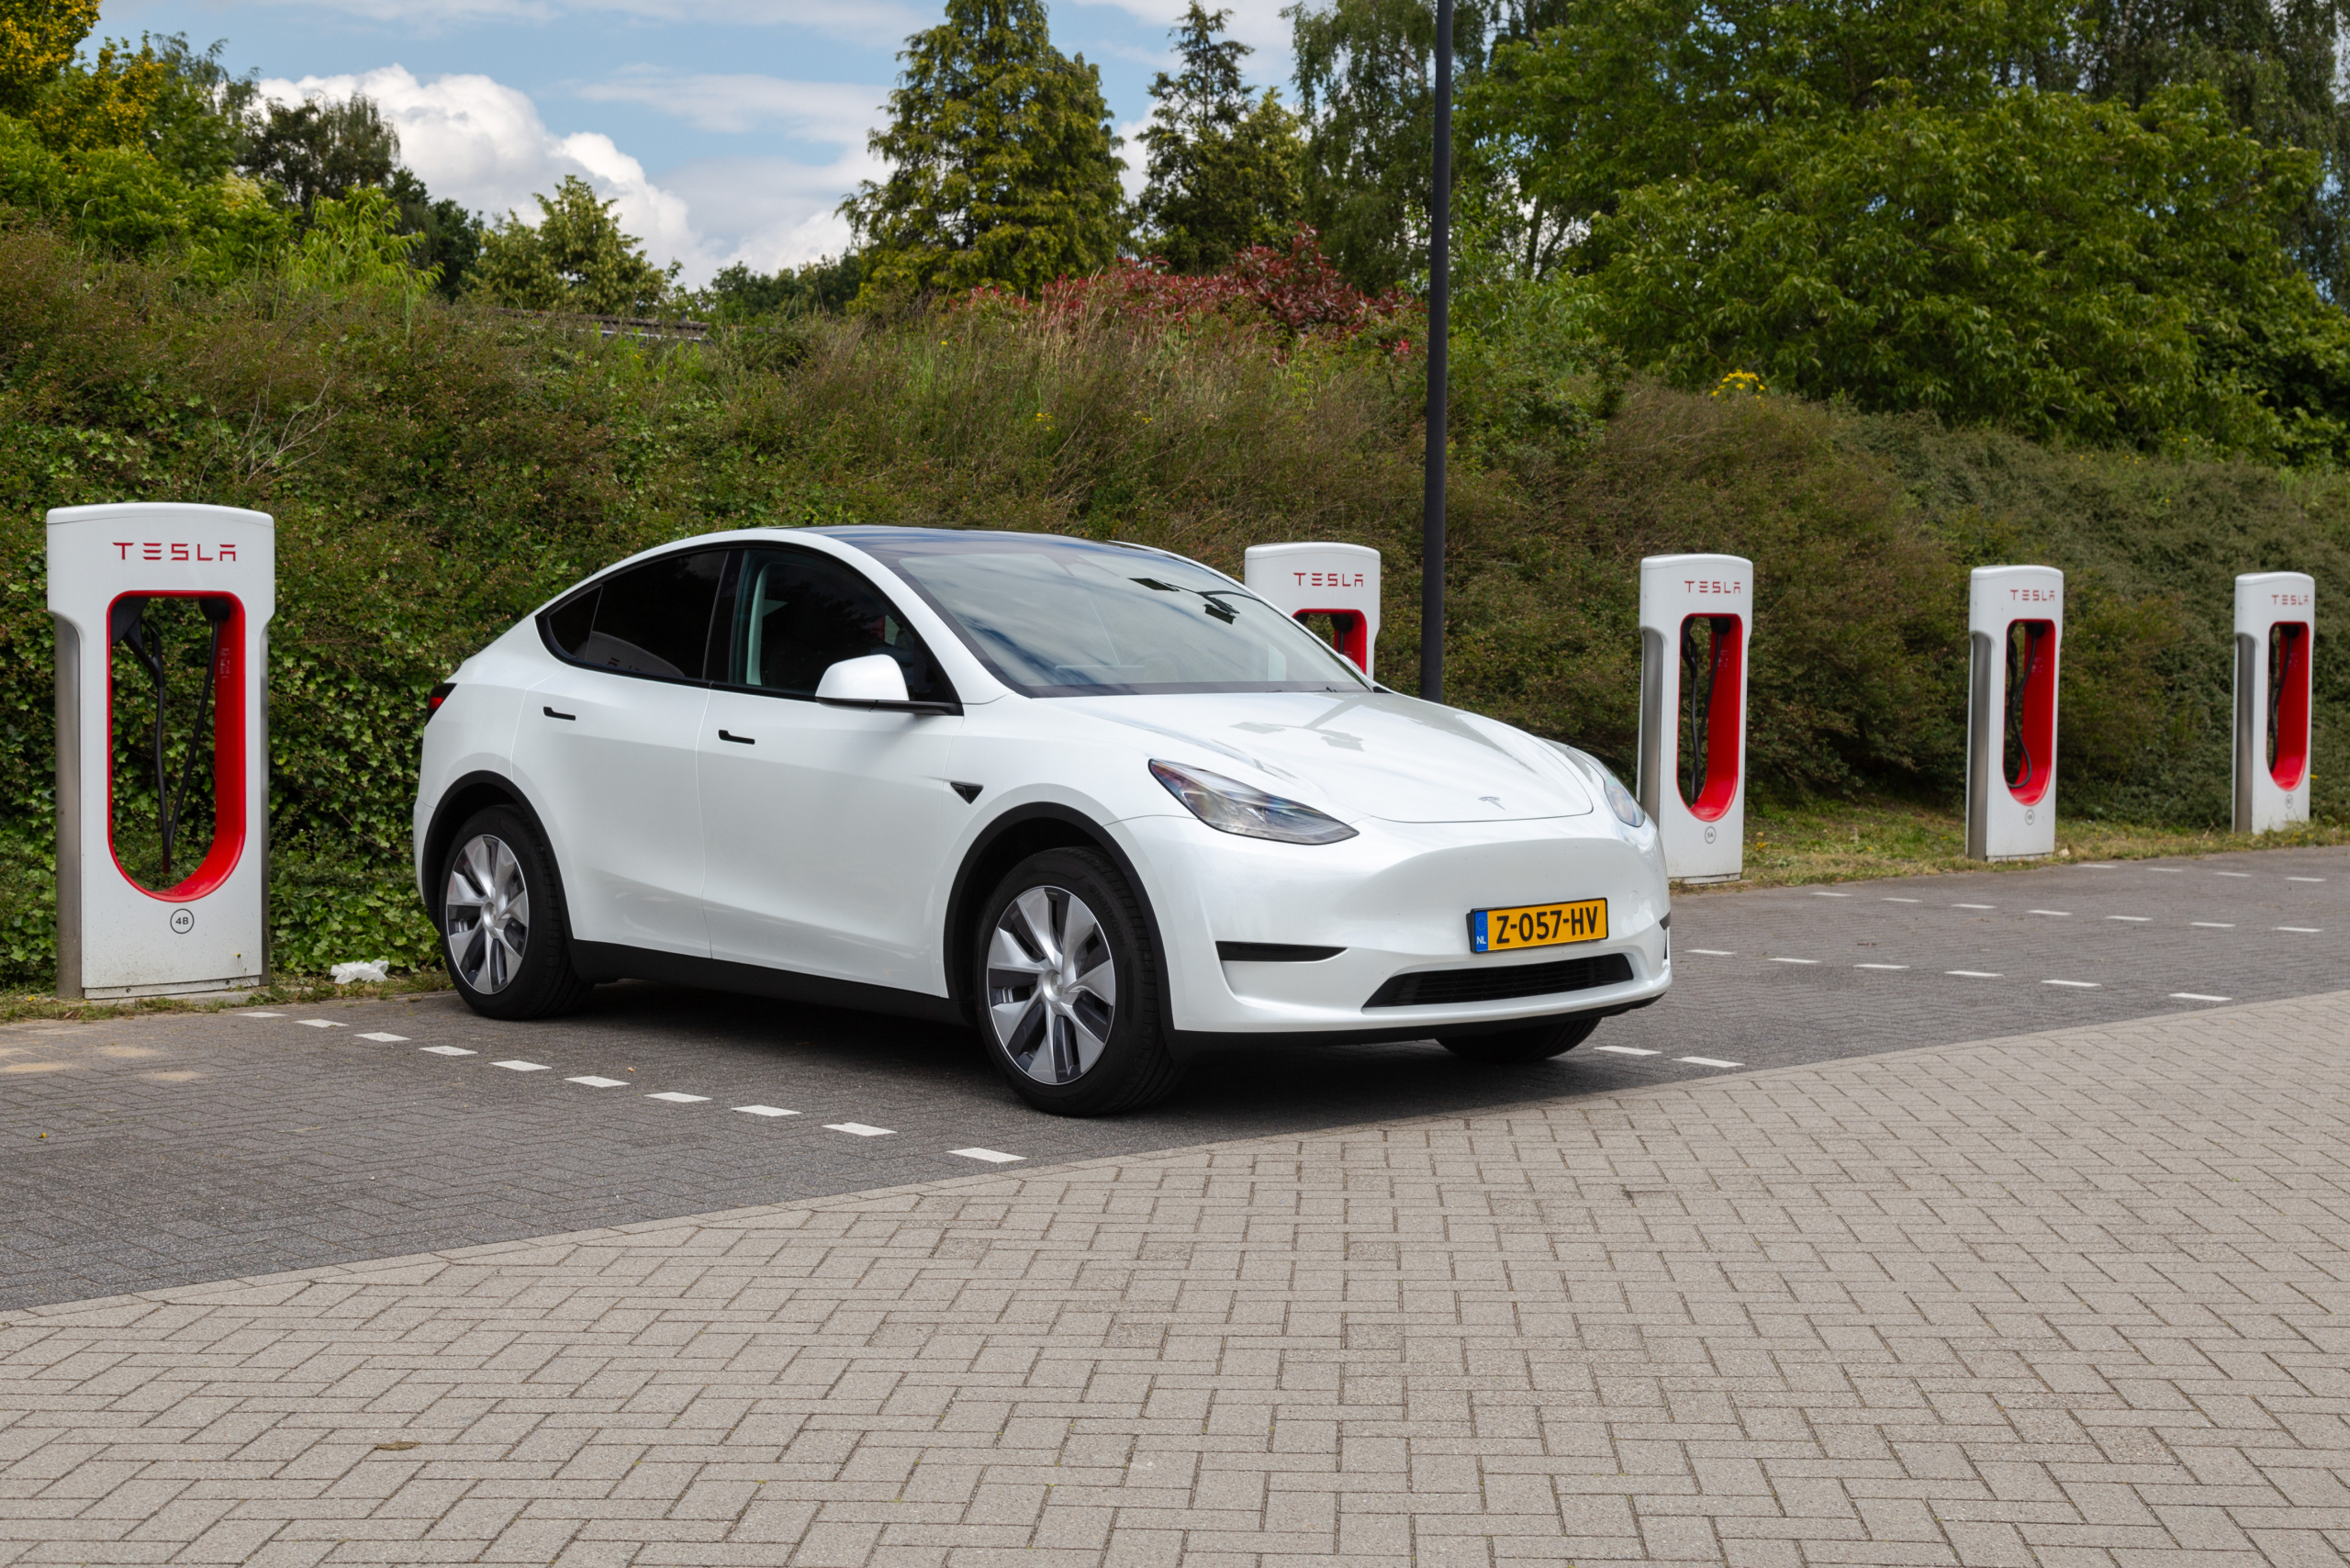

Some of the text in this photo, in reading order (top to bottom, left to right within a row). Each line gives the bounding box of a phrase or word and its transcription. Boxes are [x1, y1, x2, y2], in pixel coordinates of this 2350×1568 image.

[112, 542, 237, 562] TESLA
[1292, 572, 1364, 588] TESLA
[1684, 580, 1741, 594] TESLA
[2009, 588, 2055, 601] TESLA
[2271, 594, 2310, 606] TESLA
[175, 916, 189, 925] 4B
[1496, 905, 1598, 945] Z-057-HV
[1476, 935, 1487, 945] NL
